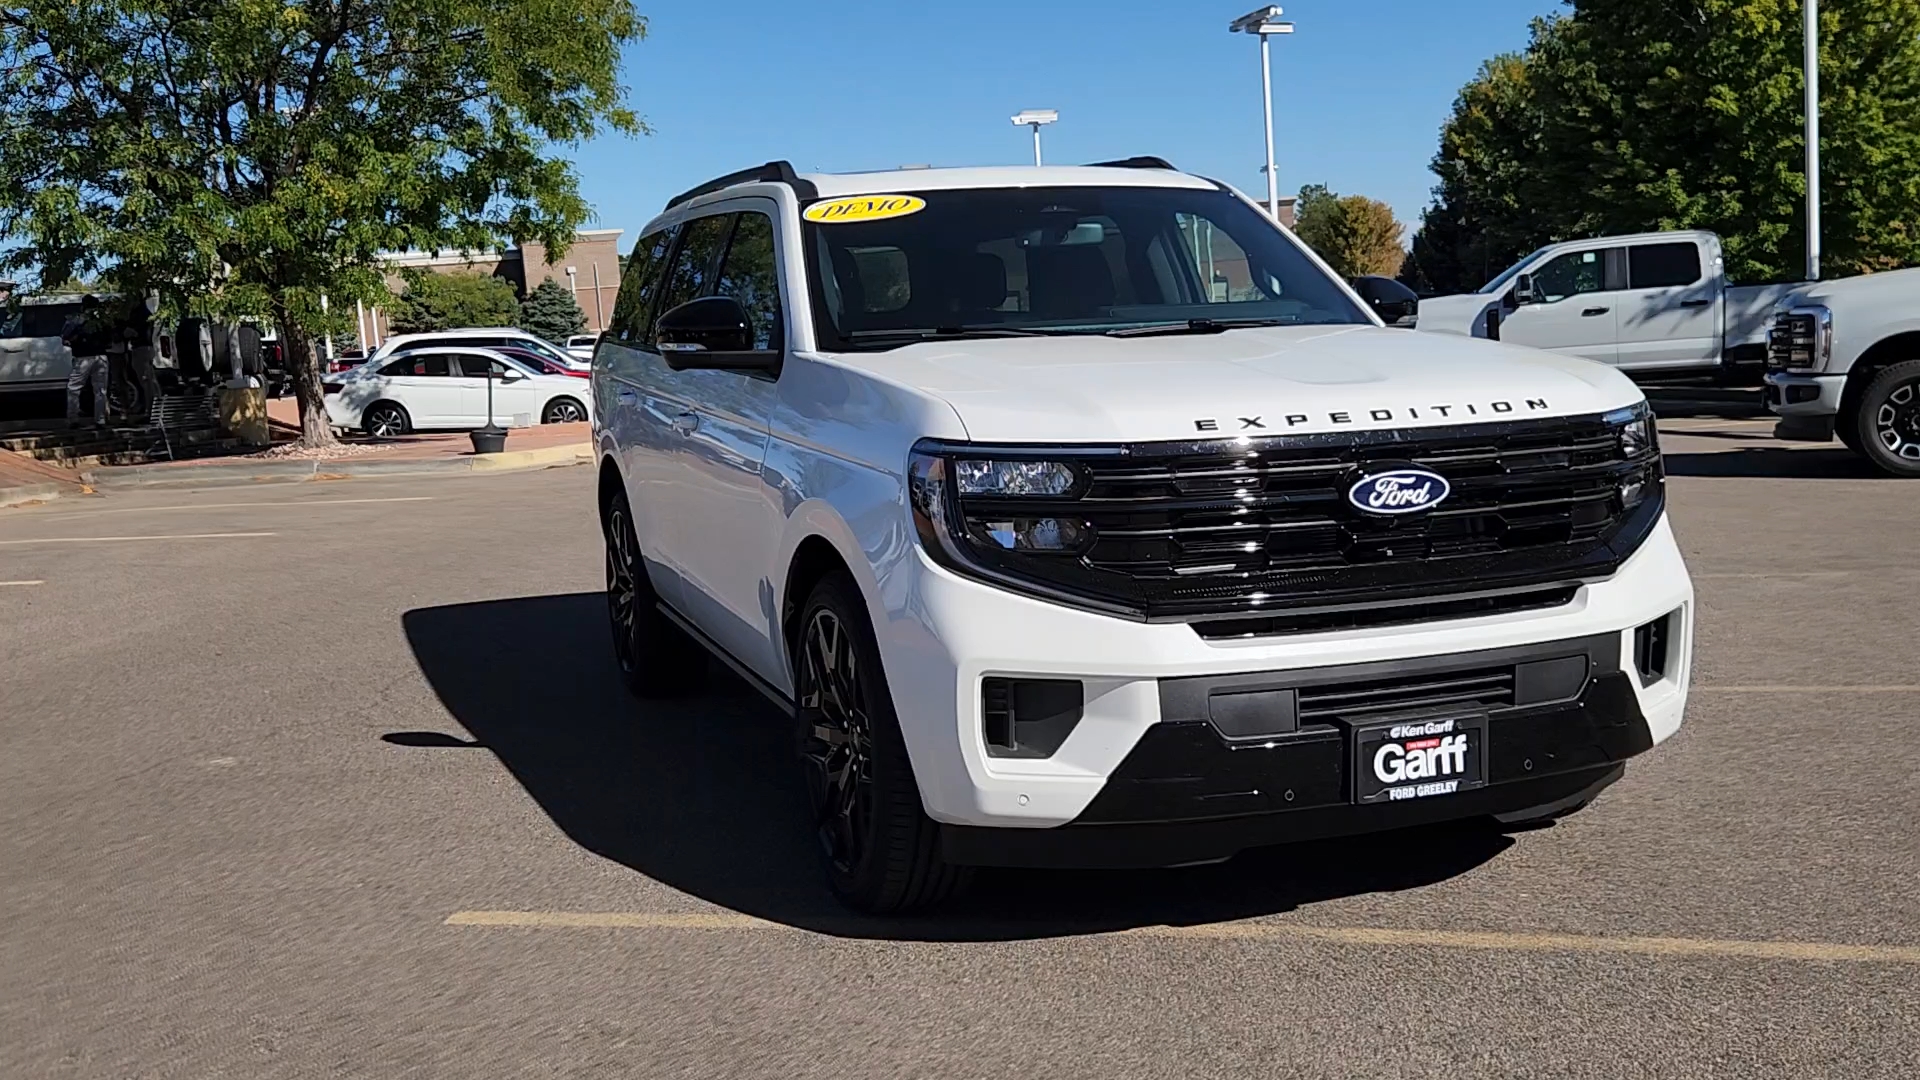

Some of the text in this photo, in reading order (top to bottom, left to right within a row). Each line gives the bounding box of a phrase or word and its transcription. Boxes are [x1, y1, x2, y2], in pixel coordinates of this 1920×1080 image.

[820, 199, 911, 219] DEMO
[1194, 397, 1549, 432] EXPEDITION
[1369, 475, 1432, 507] Ford
[1400, 719, 1454, 738] Ken Garff
[1373, 734, 1467, 783] Garff
[1389, 780, 1458, 800] FORD GREELEY
